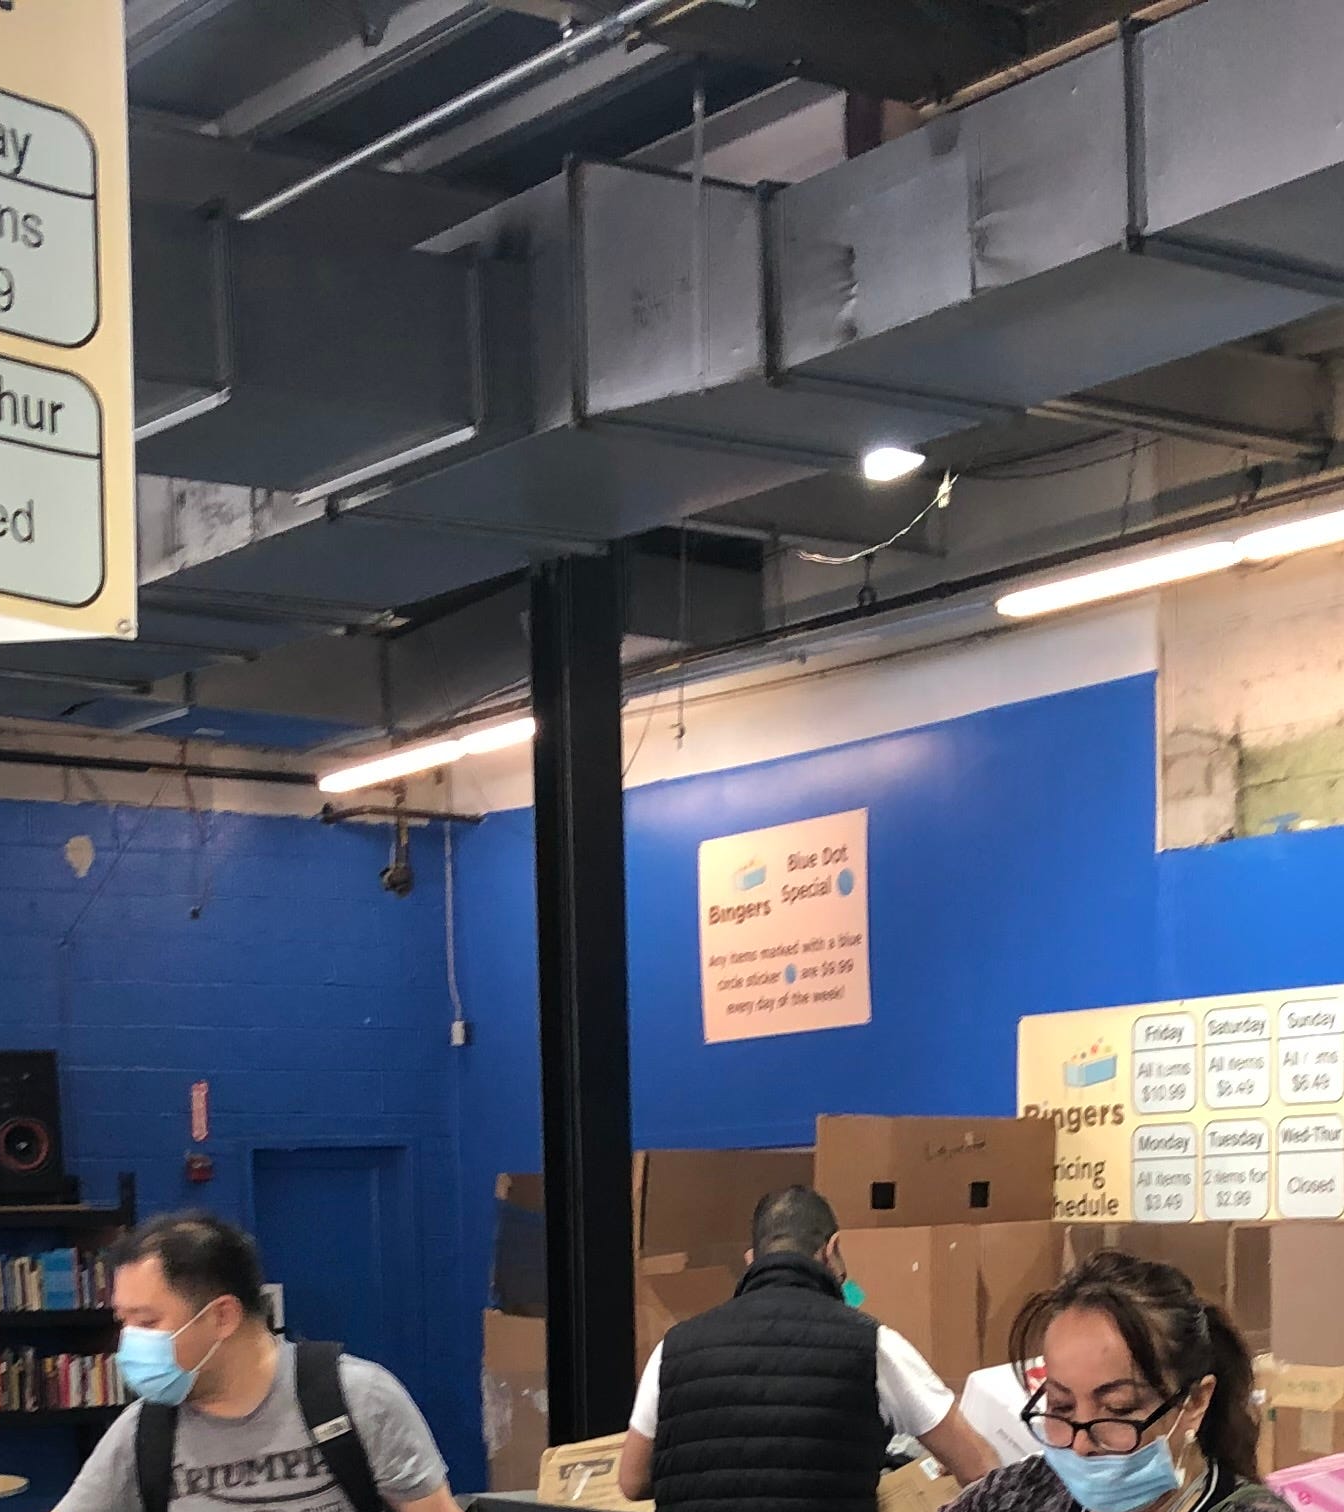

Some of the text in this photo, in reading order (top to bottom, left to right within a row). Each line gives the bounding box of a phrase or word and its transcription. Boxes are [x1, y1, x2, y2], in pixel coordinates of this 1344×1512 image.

[787, 844, 849, 873] Blue Dot
[781, 875, 833, 905] Special
[708, 899, 772, 925] Bingers
[1053, 1156, 1106, 1190] ricing
[1053, 1192, 1119, 1217] hedule
